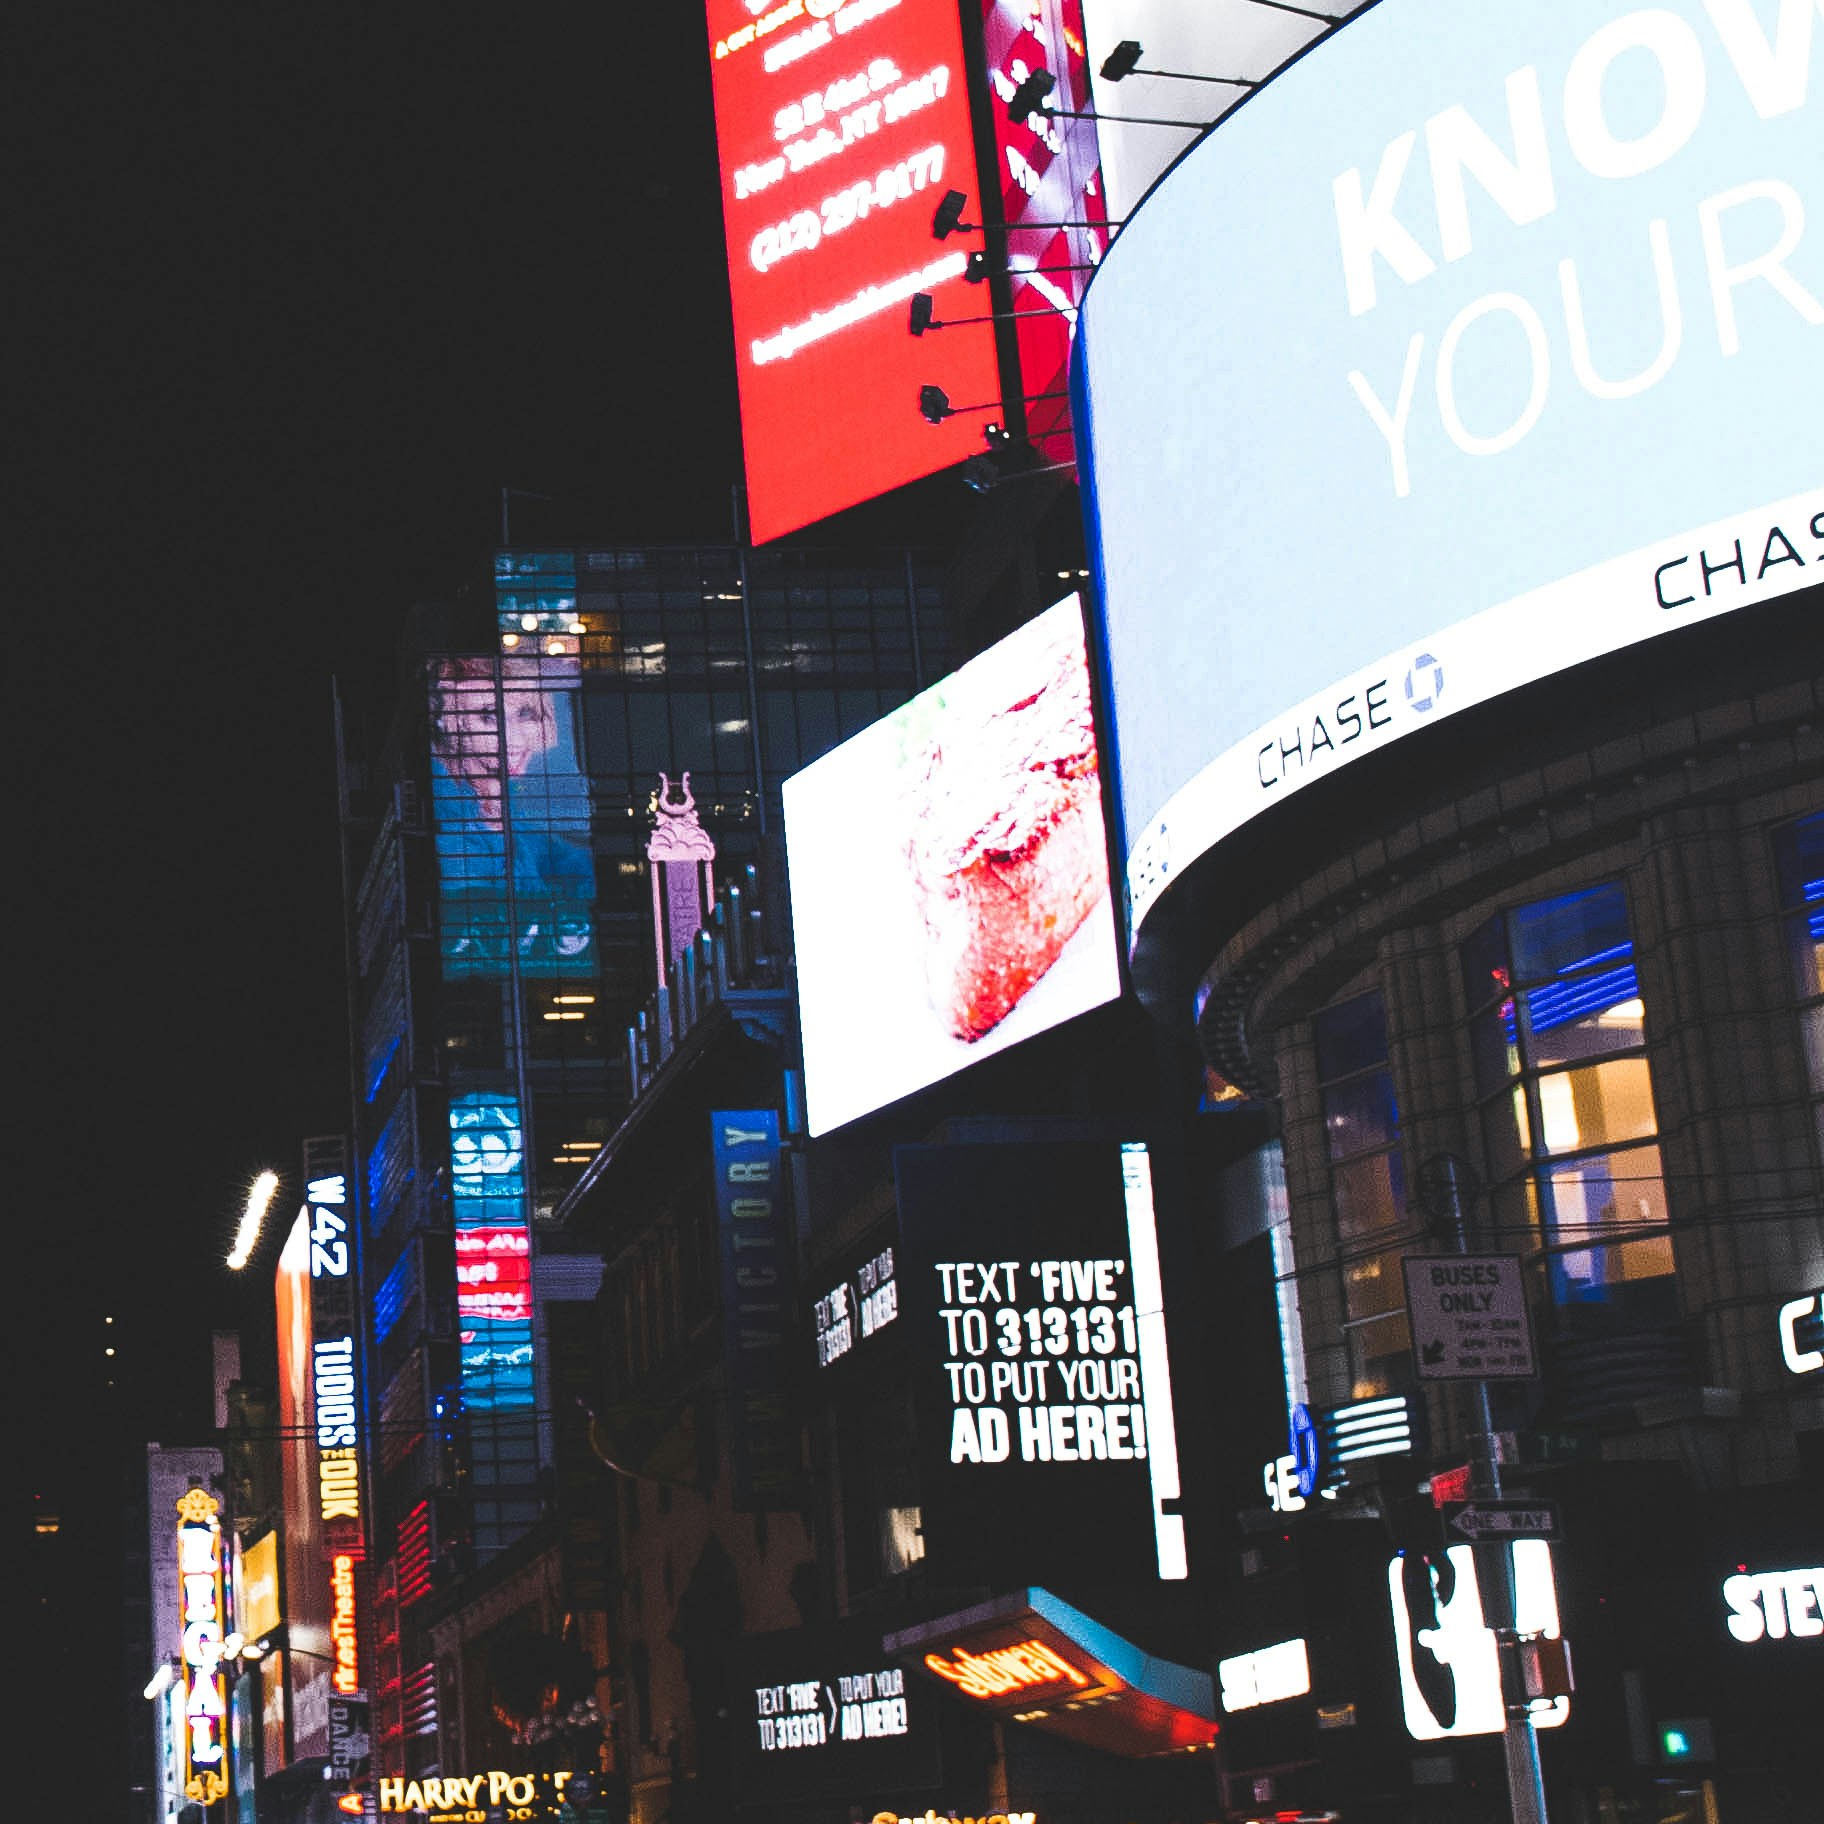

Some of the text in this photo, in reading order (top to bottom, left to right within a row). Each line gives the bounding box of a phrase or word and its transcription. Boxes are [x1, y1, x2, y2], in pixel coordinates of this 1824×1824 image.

[1347, 178, 1824, 498] YOUR
[1256, 678, 1394, 789] CHASE
[724, 1127, 781, 1350] VICTORY
[935, 1262, 1020, 1304] TEXT
[1030, 1259, 1125, 1302] 'FIVE'
[1431, 1265, 1499, 1287] BUSES
[1440, 1292, 1493, 1314] ONLY
[938, 1305, 1138, 1357] TO 313131
[943, 1358, 1141, 1404] TO PUT YOUR
[950, 1403, 1147, 1464] AD HERE!
[1461, 1511, 1545, 1529] ONE WAY
[874, 1669, 904, 1698] YOUR
[924, 1639, 1089, 1699] Subway
[756, 1685, 785, 1715] TEXT
[842, 1704, 862, 1741] AD
[331, 1707, 351, 1781] DANCE
[757, 1712, 826, 1751] TO 313131
[379, 1774, 484, 1813] HARRY
